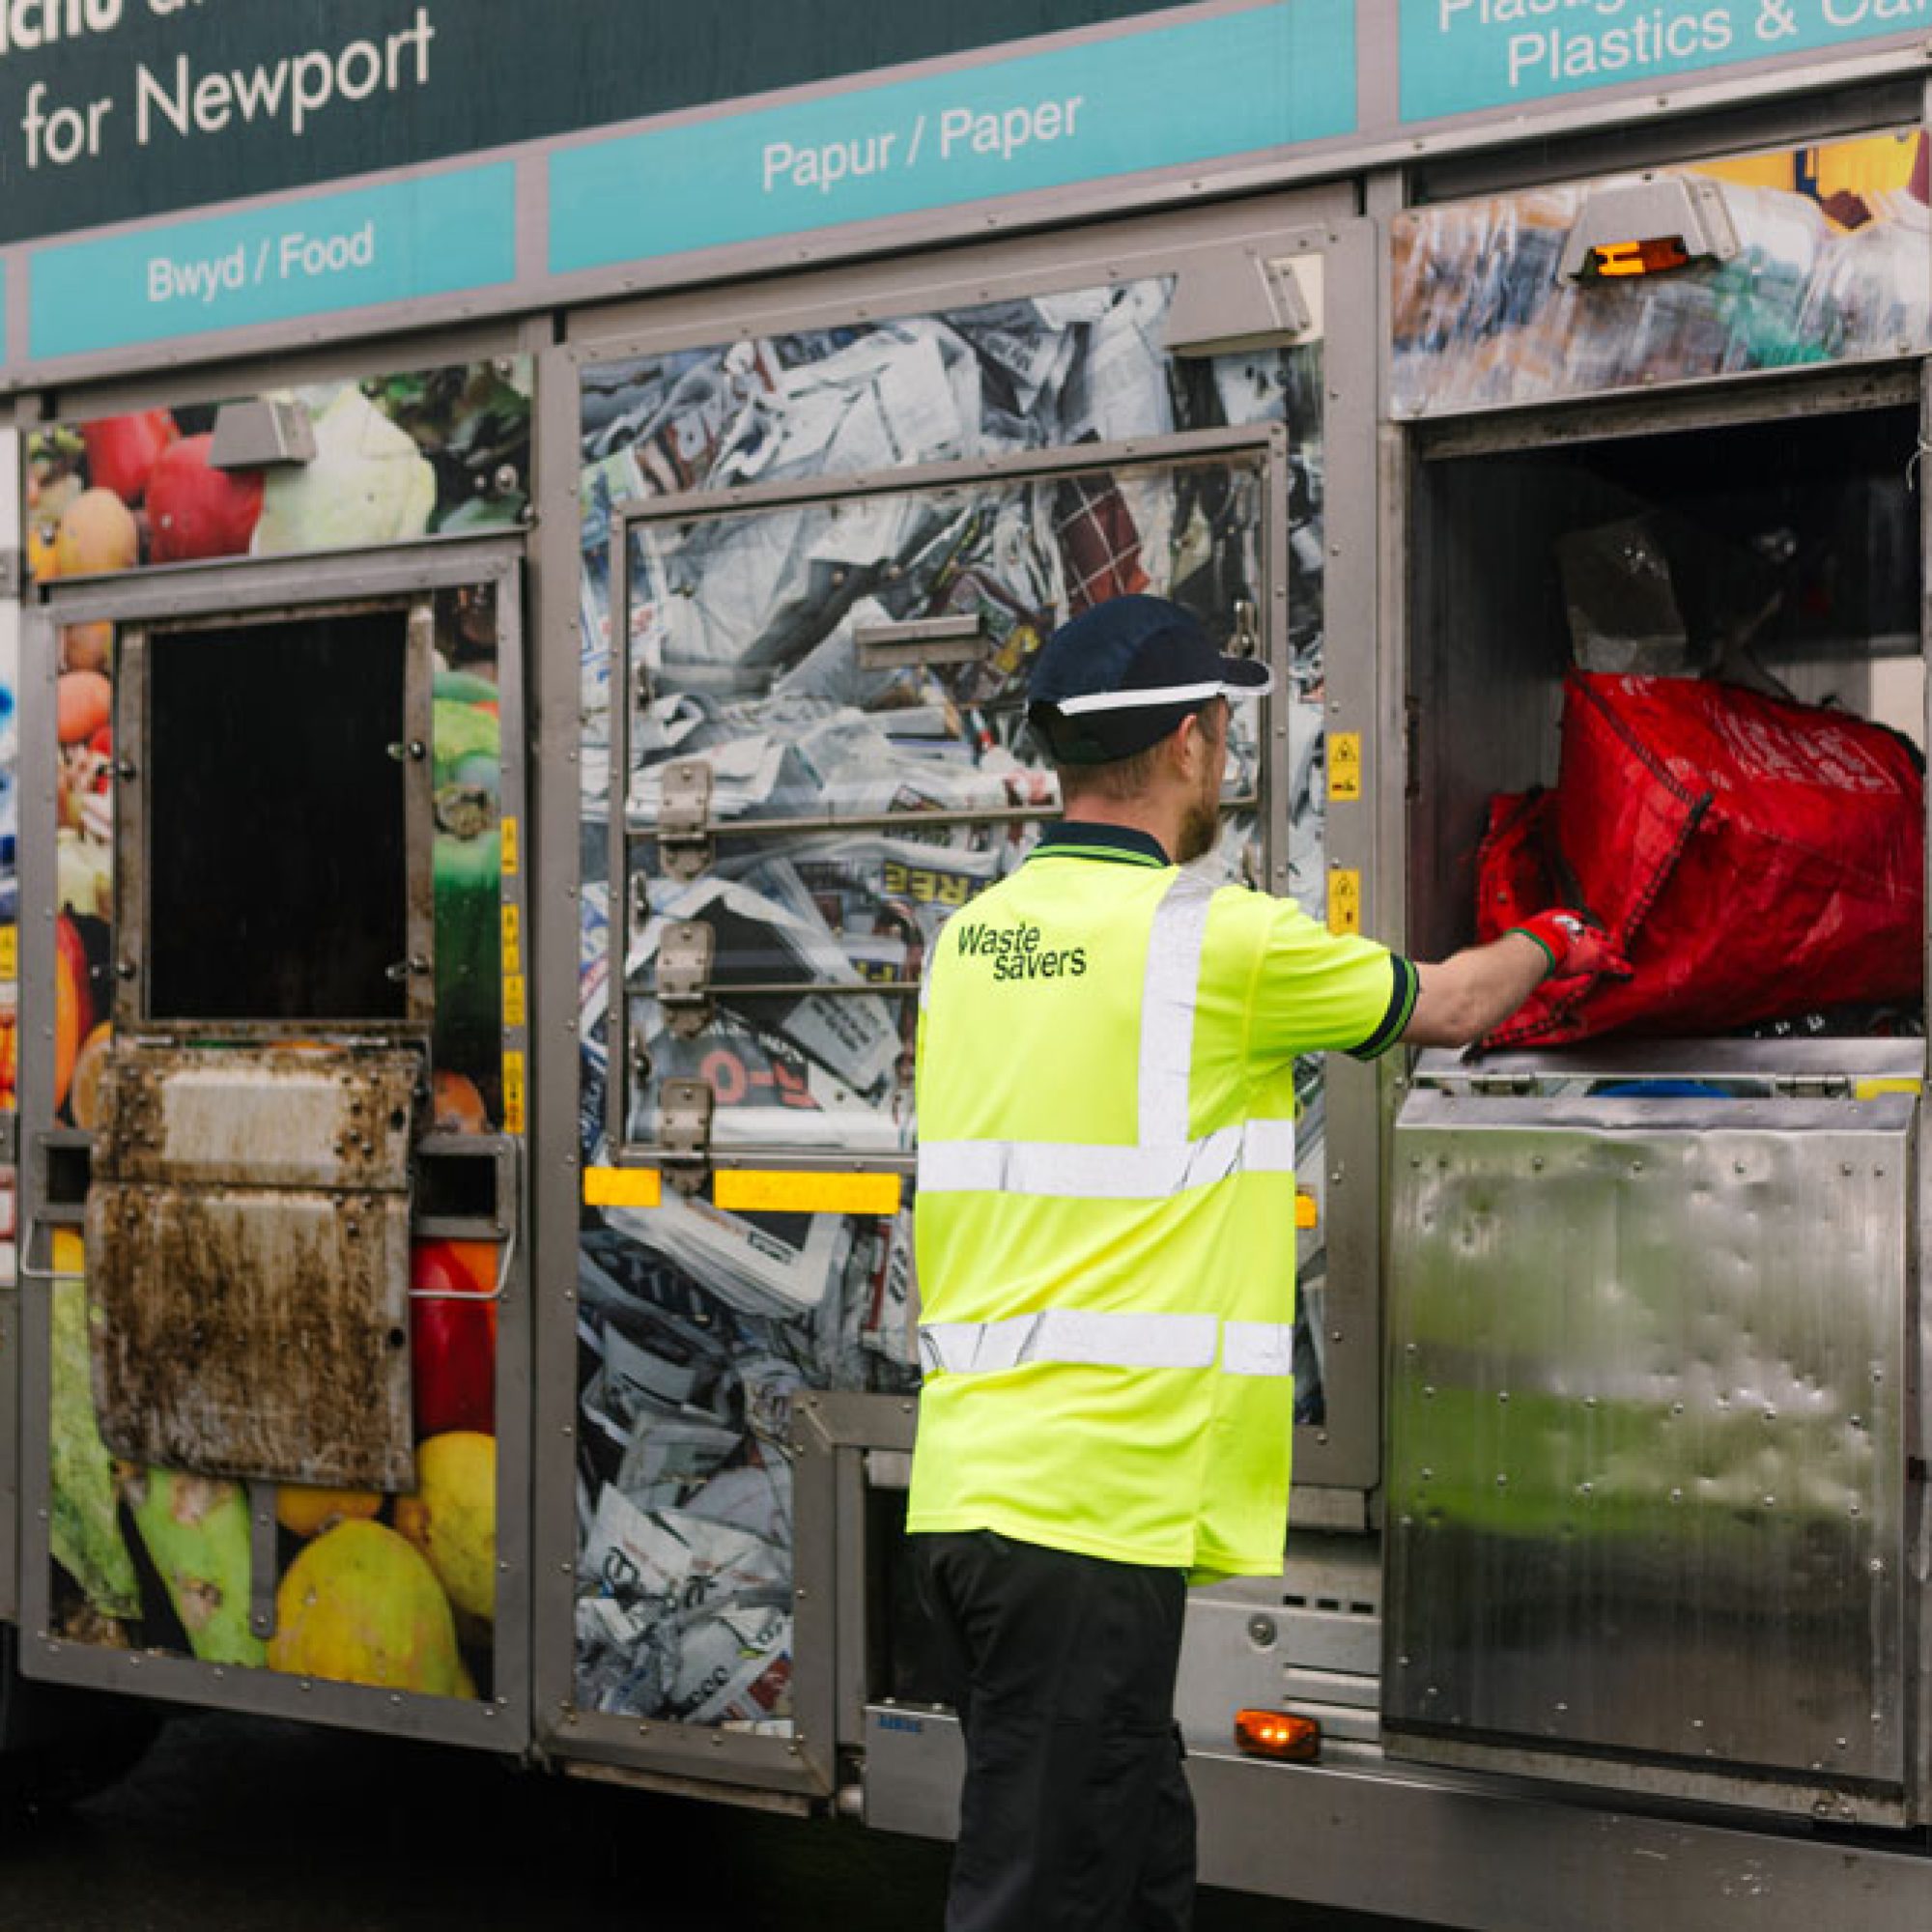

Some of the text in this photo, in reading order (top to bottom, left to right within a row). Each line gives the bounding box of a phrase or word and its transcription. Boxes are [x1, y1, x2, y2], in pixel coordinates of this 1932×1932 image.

[1509, 9, 1732, 87] Plastics
[1754, 0, 1800, 40] &
[22, 6, 435, 169] for Newport
[762, 96, 1084, 193] Papur / Paper
[147, 219, 375, 302] Bwyd / Food
[958, 922, 1041, 956] Waste
[993, 947, 1088, 981] savers
